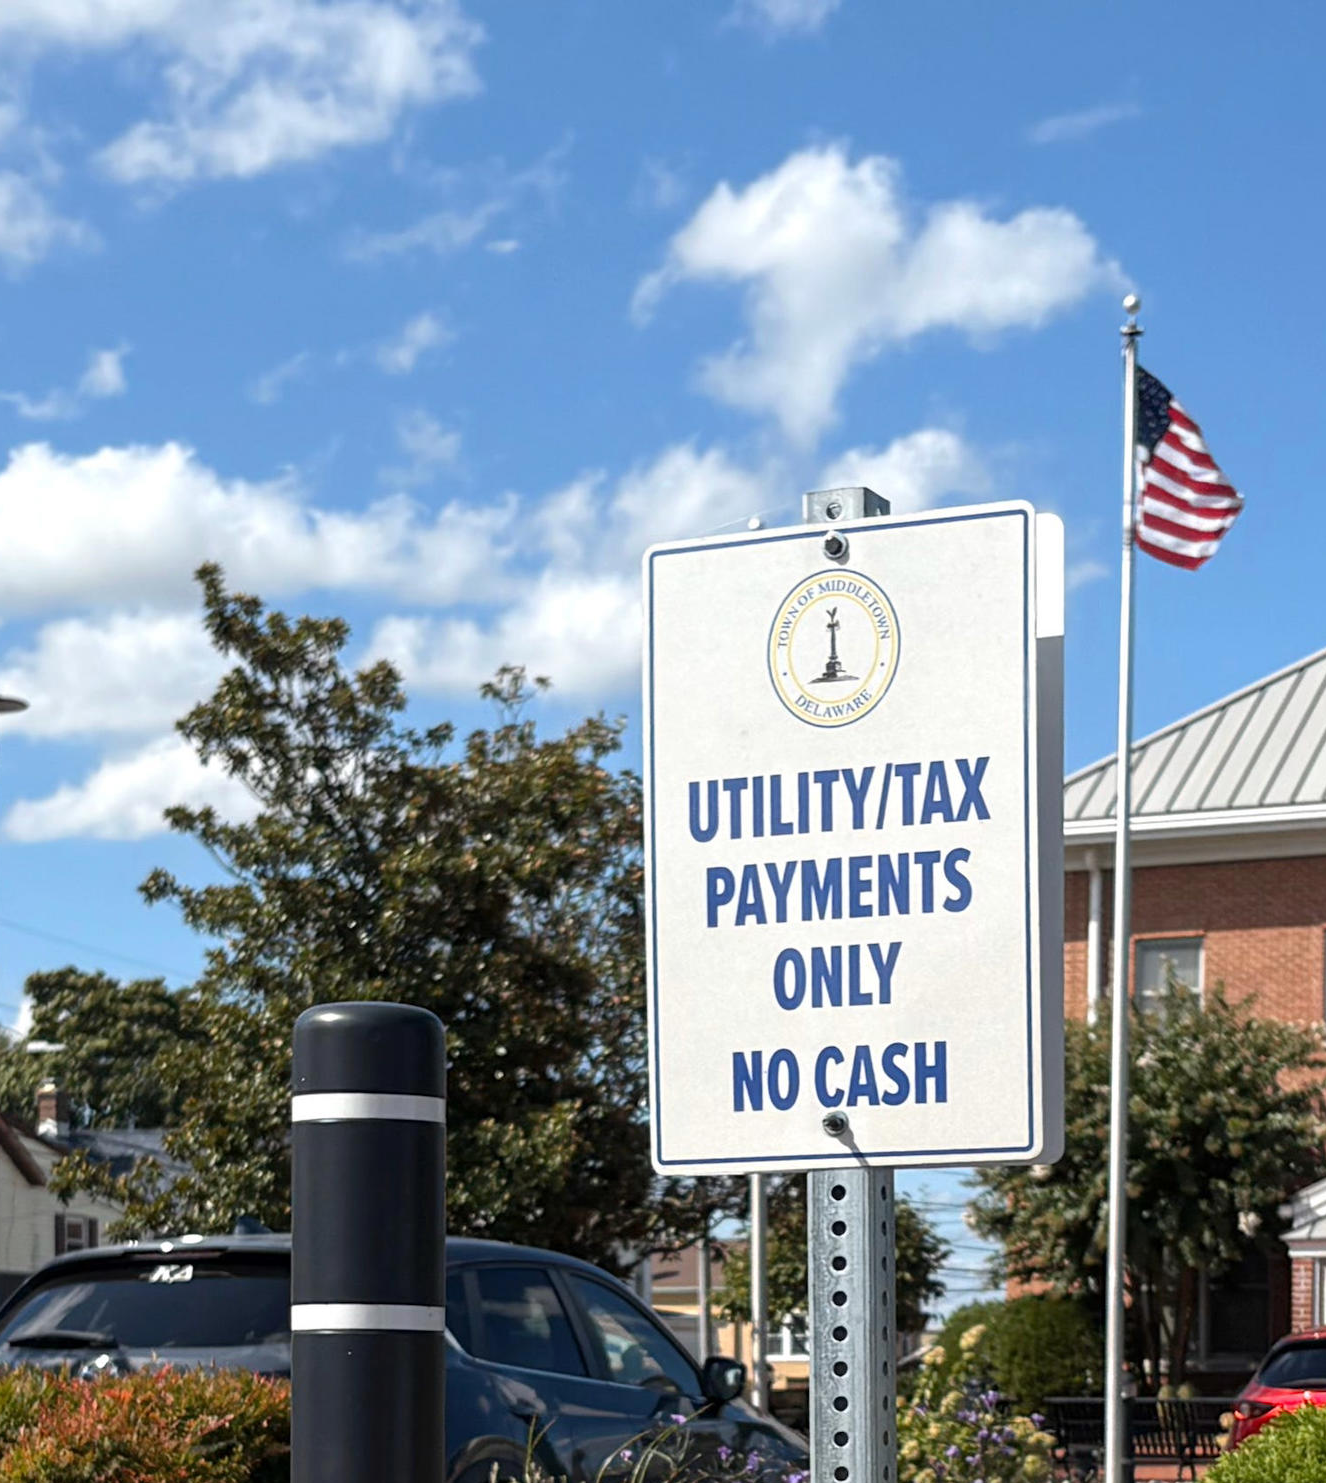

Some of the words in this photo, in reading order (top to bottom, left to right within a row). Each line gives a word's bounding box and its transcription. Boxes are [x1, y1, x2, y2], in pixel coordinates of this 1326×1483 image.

[778, 606, 800, 649] TOWN
[797, 587, 816, 607] OF
[818, 579, 891, 640] MIDDLETOWN
[794, 688, 873, 718] DELAWARE
[688, 756, 991, 843] UTILITY/TAX
[706, 847, 973, 928] PAYMENTS
[773, 941, 902, 1011] ONLY
[732, 1048, 800, 1113] NO
[814, 1040, 948, 1108] CASH
